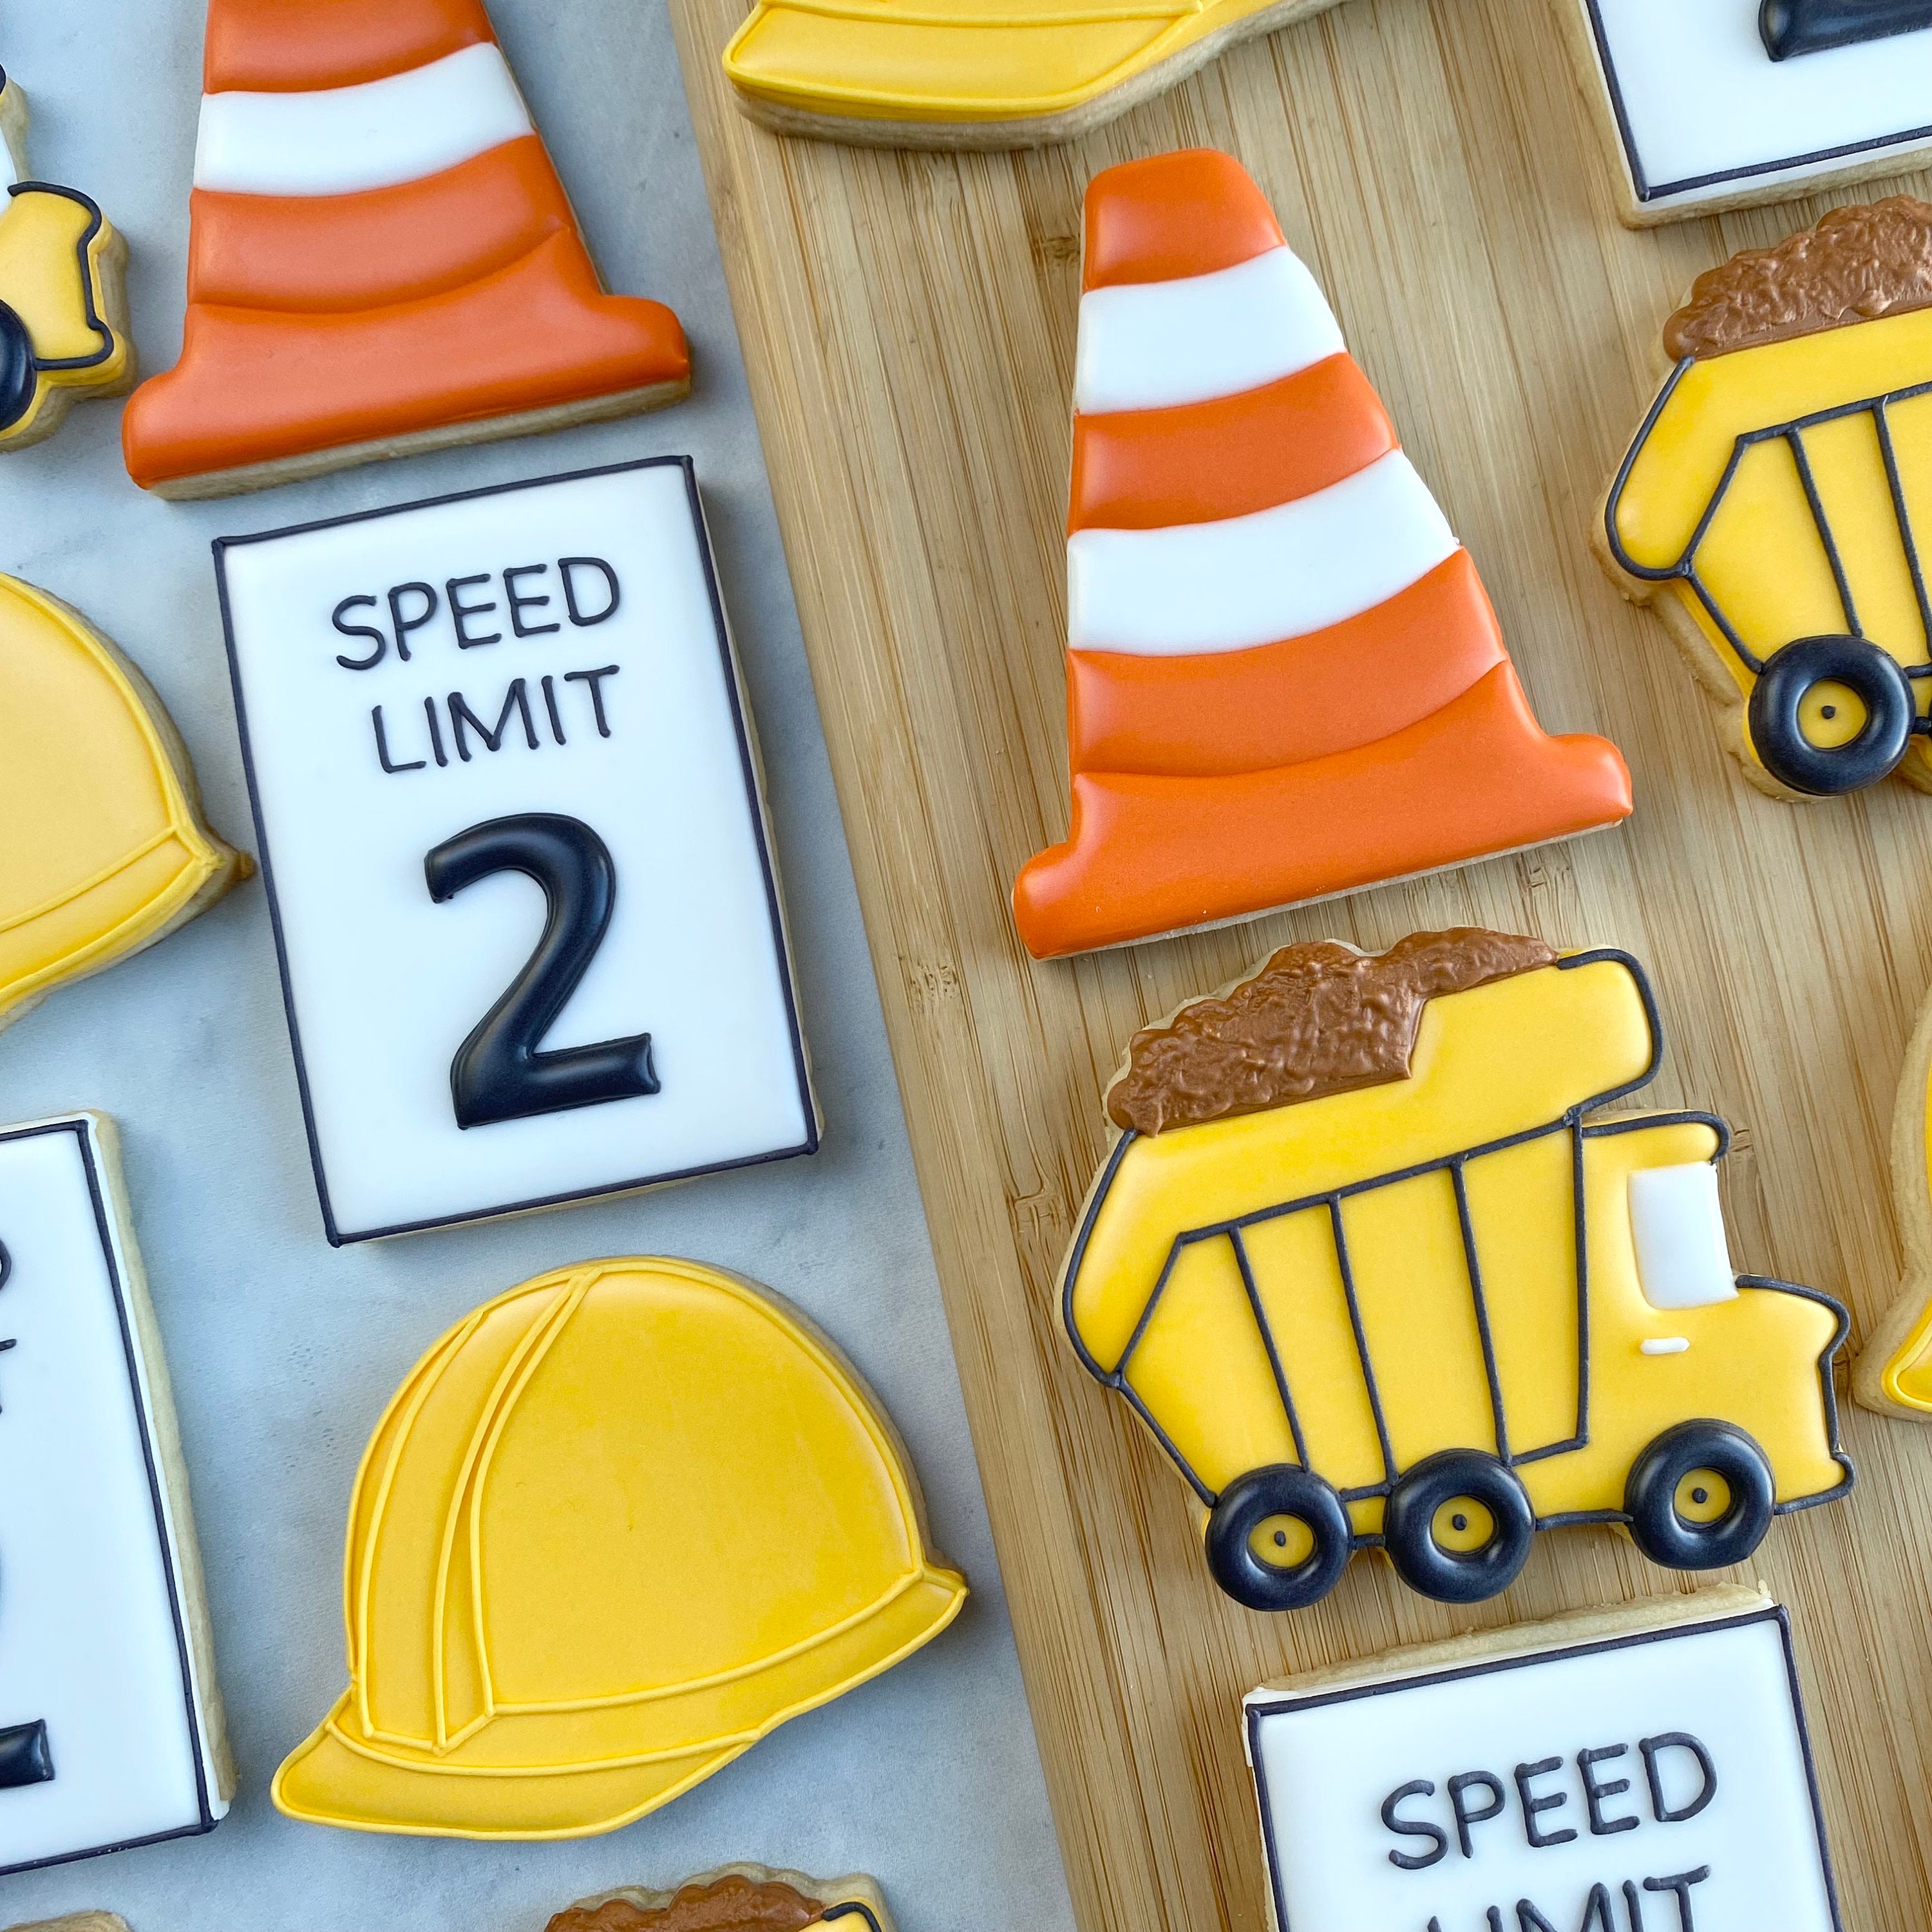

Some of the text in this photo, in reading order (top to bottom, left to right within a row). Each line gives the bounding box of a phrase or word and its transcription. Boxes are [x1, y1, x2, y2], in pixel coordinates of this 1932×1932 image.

[331, 556, 621, 672] SPEED
[370, 664, 621, 775] LIMIT
[422, 811, 662, 1132] 2
[1379, 1731, 1718, 1871] SPEED
[1425, 1864, 1711, 1932] MIT
